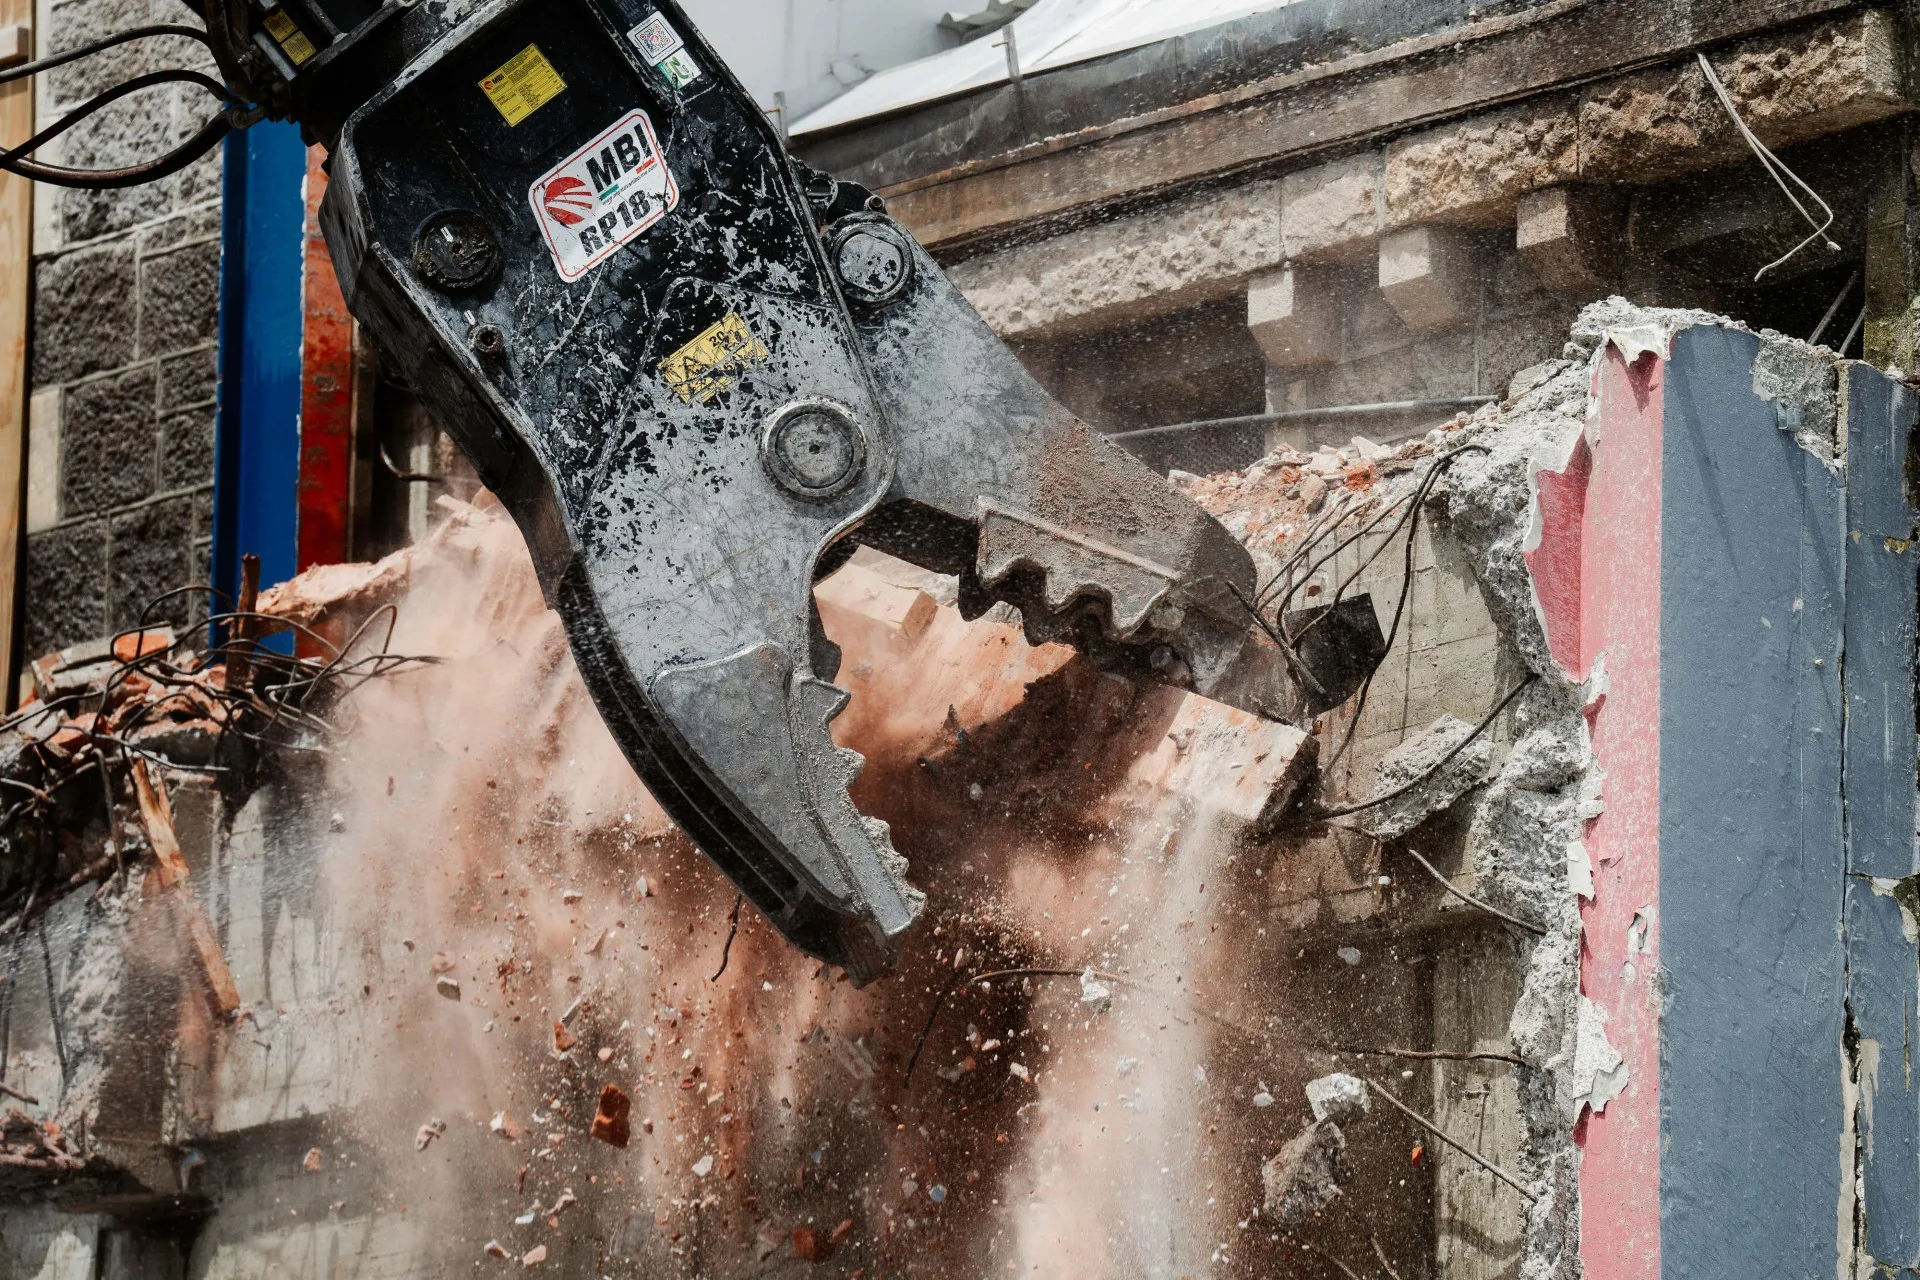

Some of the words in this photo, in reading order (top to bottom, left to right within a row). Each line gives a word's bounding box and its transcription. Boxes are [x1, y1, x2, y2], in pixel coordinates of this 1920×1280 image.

[491, 72, 505, 85] MBI
[585, 123, 653, 194] MBI
[578, 190, 652, 258] RP18
